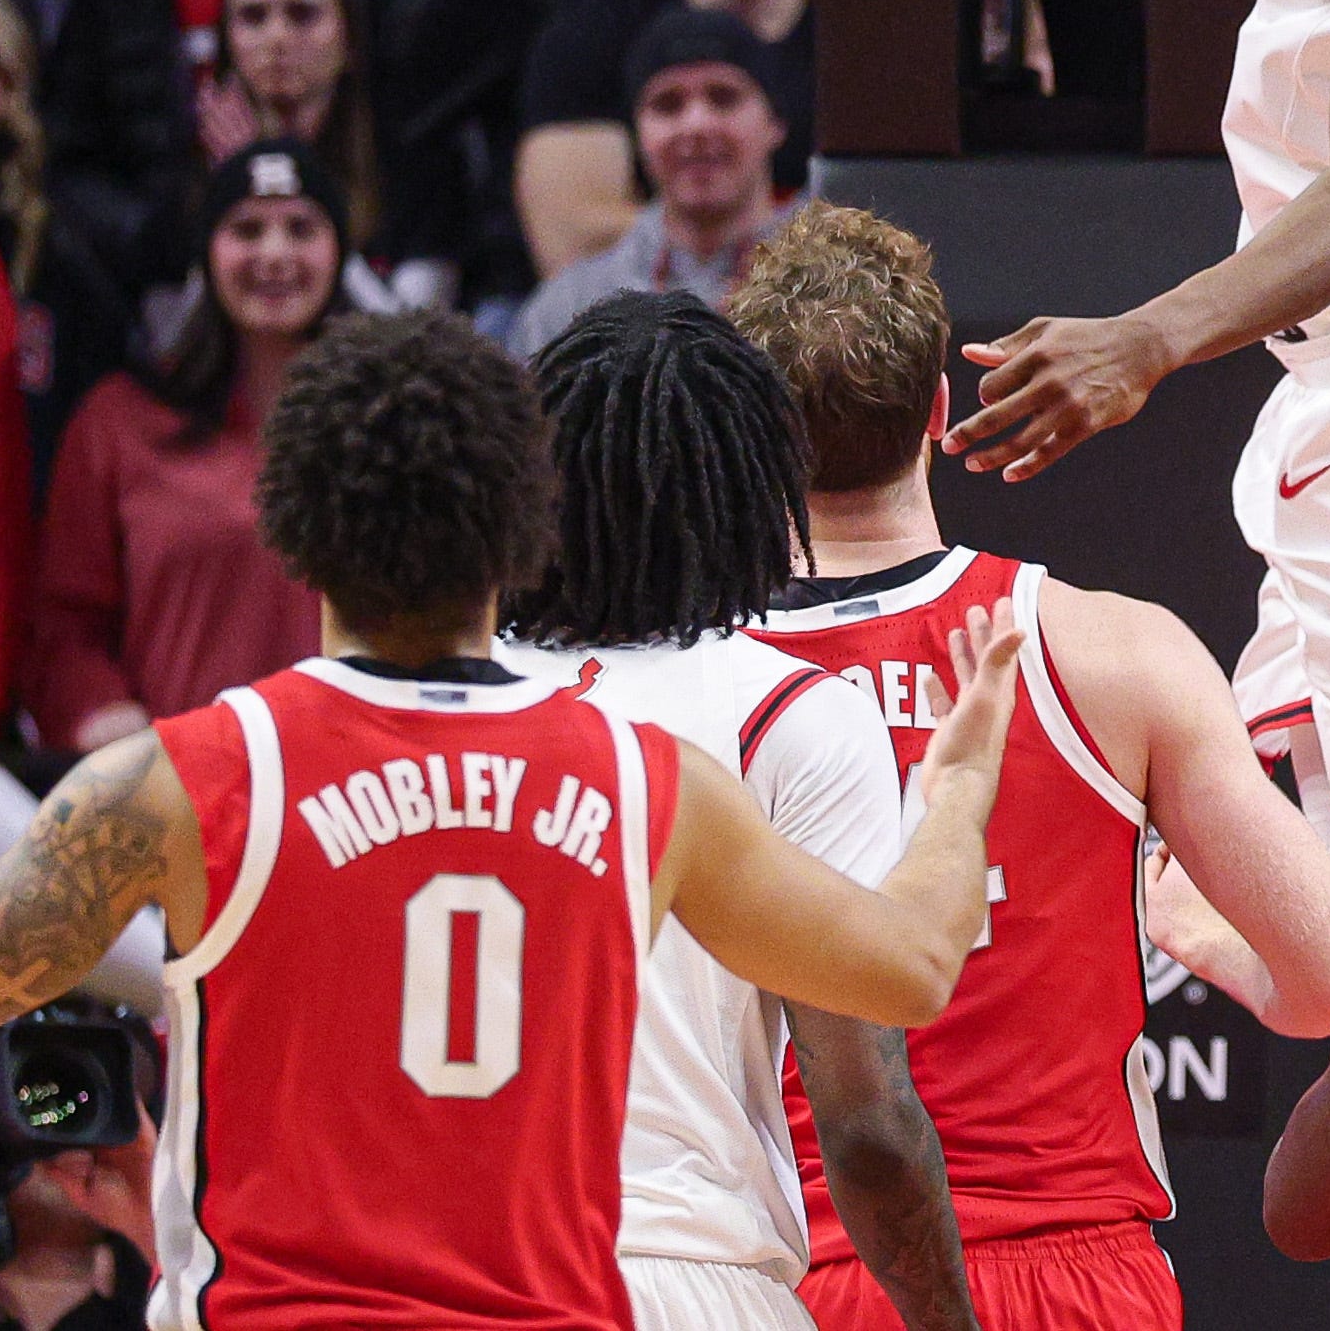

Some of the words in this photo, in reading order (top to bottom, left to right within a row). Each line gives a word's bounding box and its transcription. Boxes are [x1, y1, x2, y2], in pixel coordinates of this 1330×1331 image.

[296, 751, 527, 869] MOBLEY
[532, 774, 613, 878] JR.
[399, 873, 526, 1099] 0
